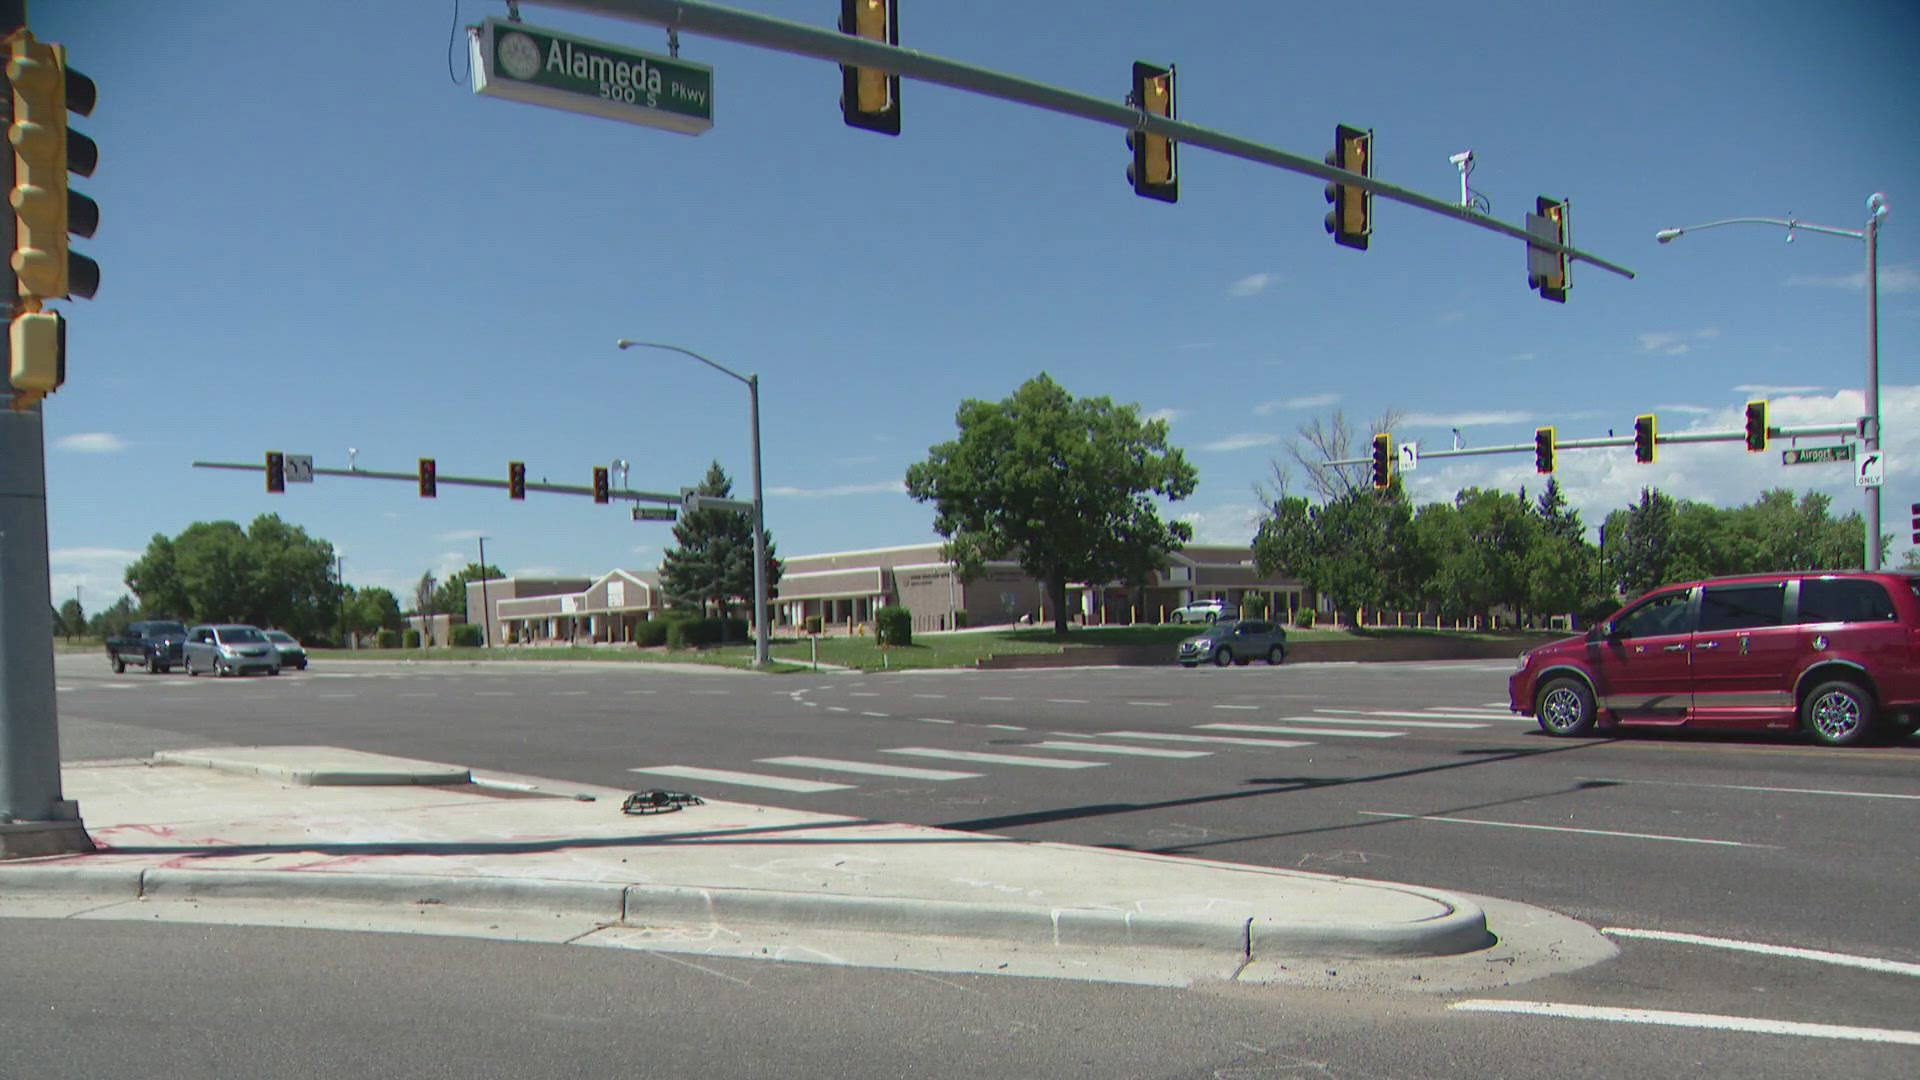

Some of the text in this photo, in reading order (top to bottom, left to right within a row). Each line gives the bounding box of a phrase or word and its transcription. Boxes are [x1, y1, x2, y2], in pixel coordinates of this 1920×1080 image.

[546, 39, 706, 105] Alameda Pkwy
[600, 83, 657, 108] 500 S
[1800, 448, 1831, 462] Airport
[1859, 476, 1880, 485] ONLY
